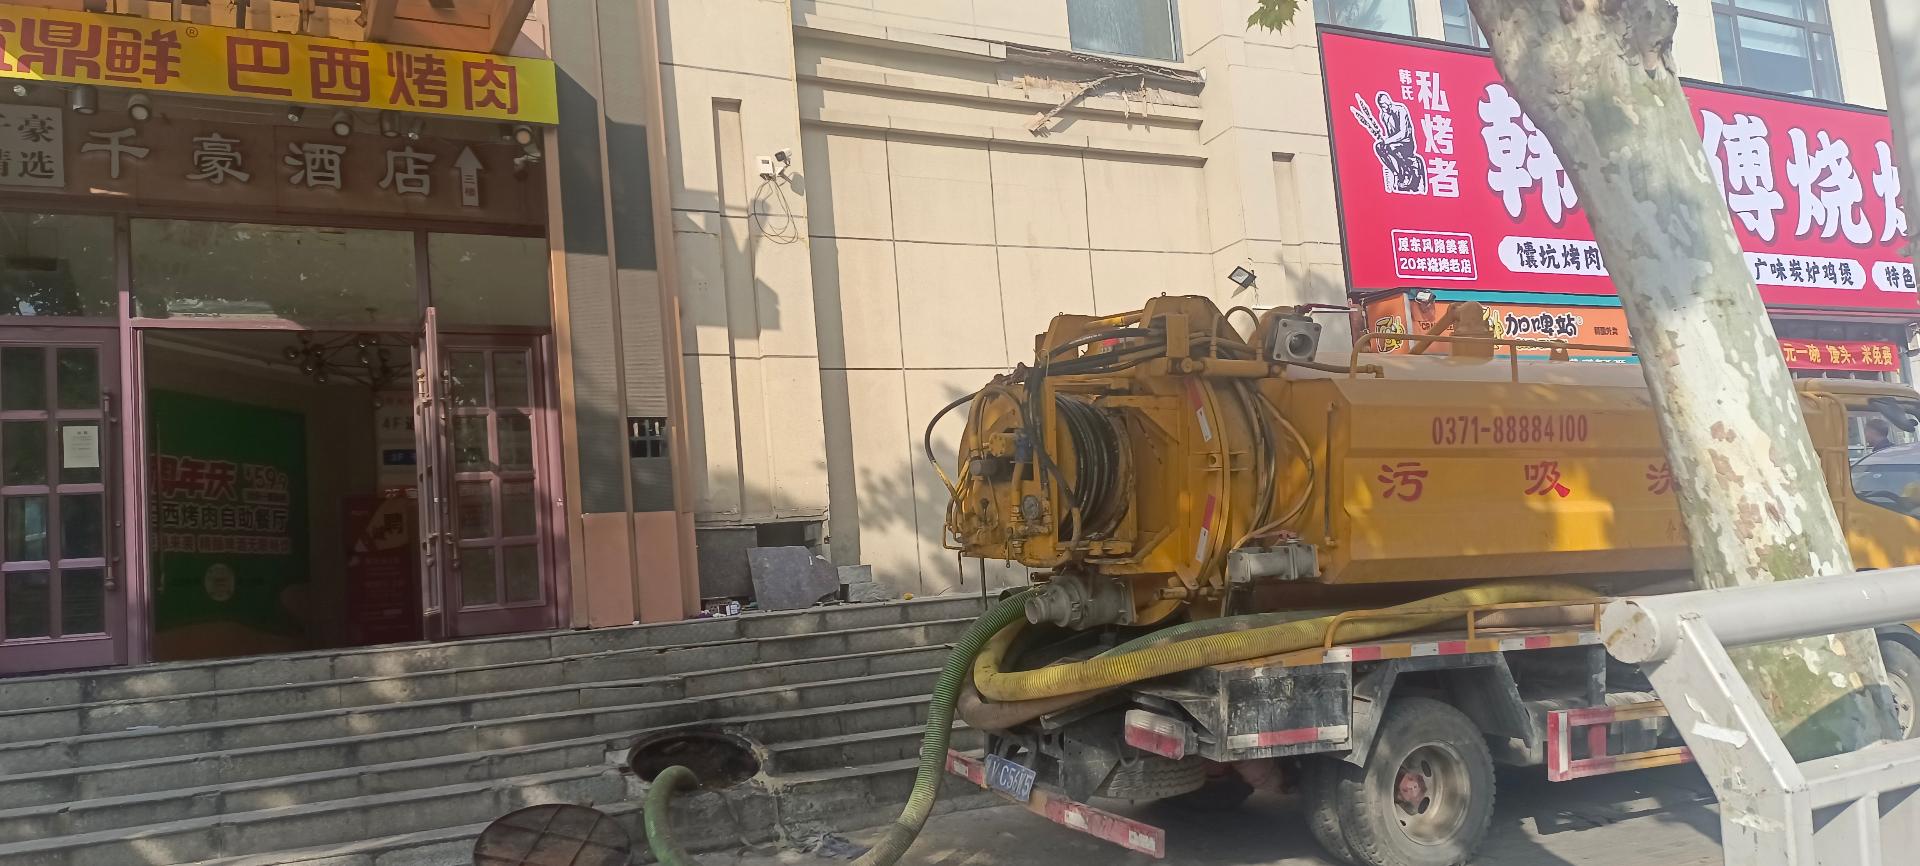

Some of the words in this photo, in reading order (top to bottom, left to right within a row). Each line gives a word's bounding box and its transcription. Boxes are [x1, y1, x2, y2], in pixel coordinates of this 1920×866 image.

[227, 36, 518, 114] 巴西烤肉
[1398, 69, 1414, 101] 韩氏
[1415, 70, 1460, 198] 私烤者
[81, 127, 437, 196] 千豪酒店
[1399, 257, 1472, 274] 20年烧烤老店
[1516, 241, 1600, 271] 馕坑烤肉
[1754, 257, 1854, 286] 广味炭炉鸡煲
[1884, 266, 1916, 289] 特色
[1432, 414, 1588, 445] 0371-88884100
